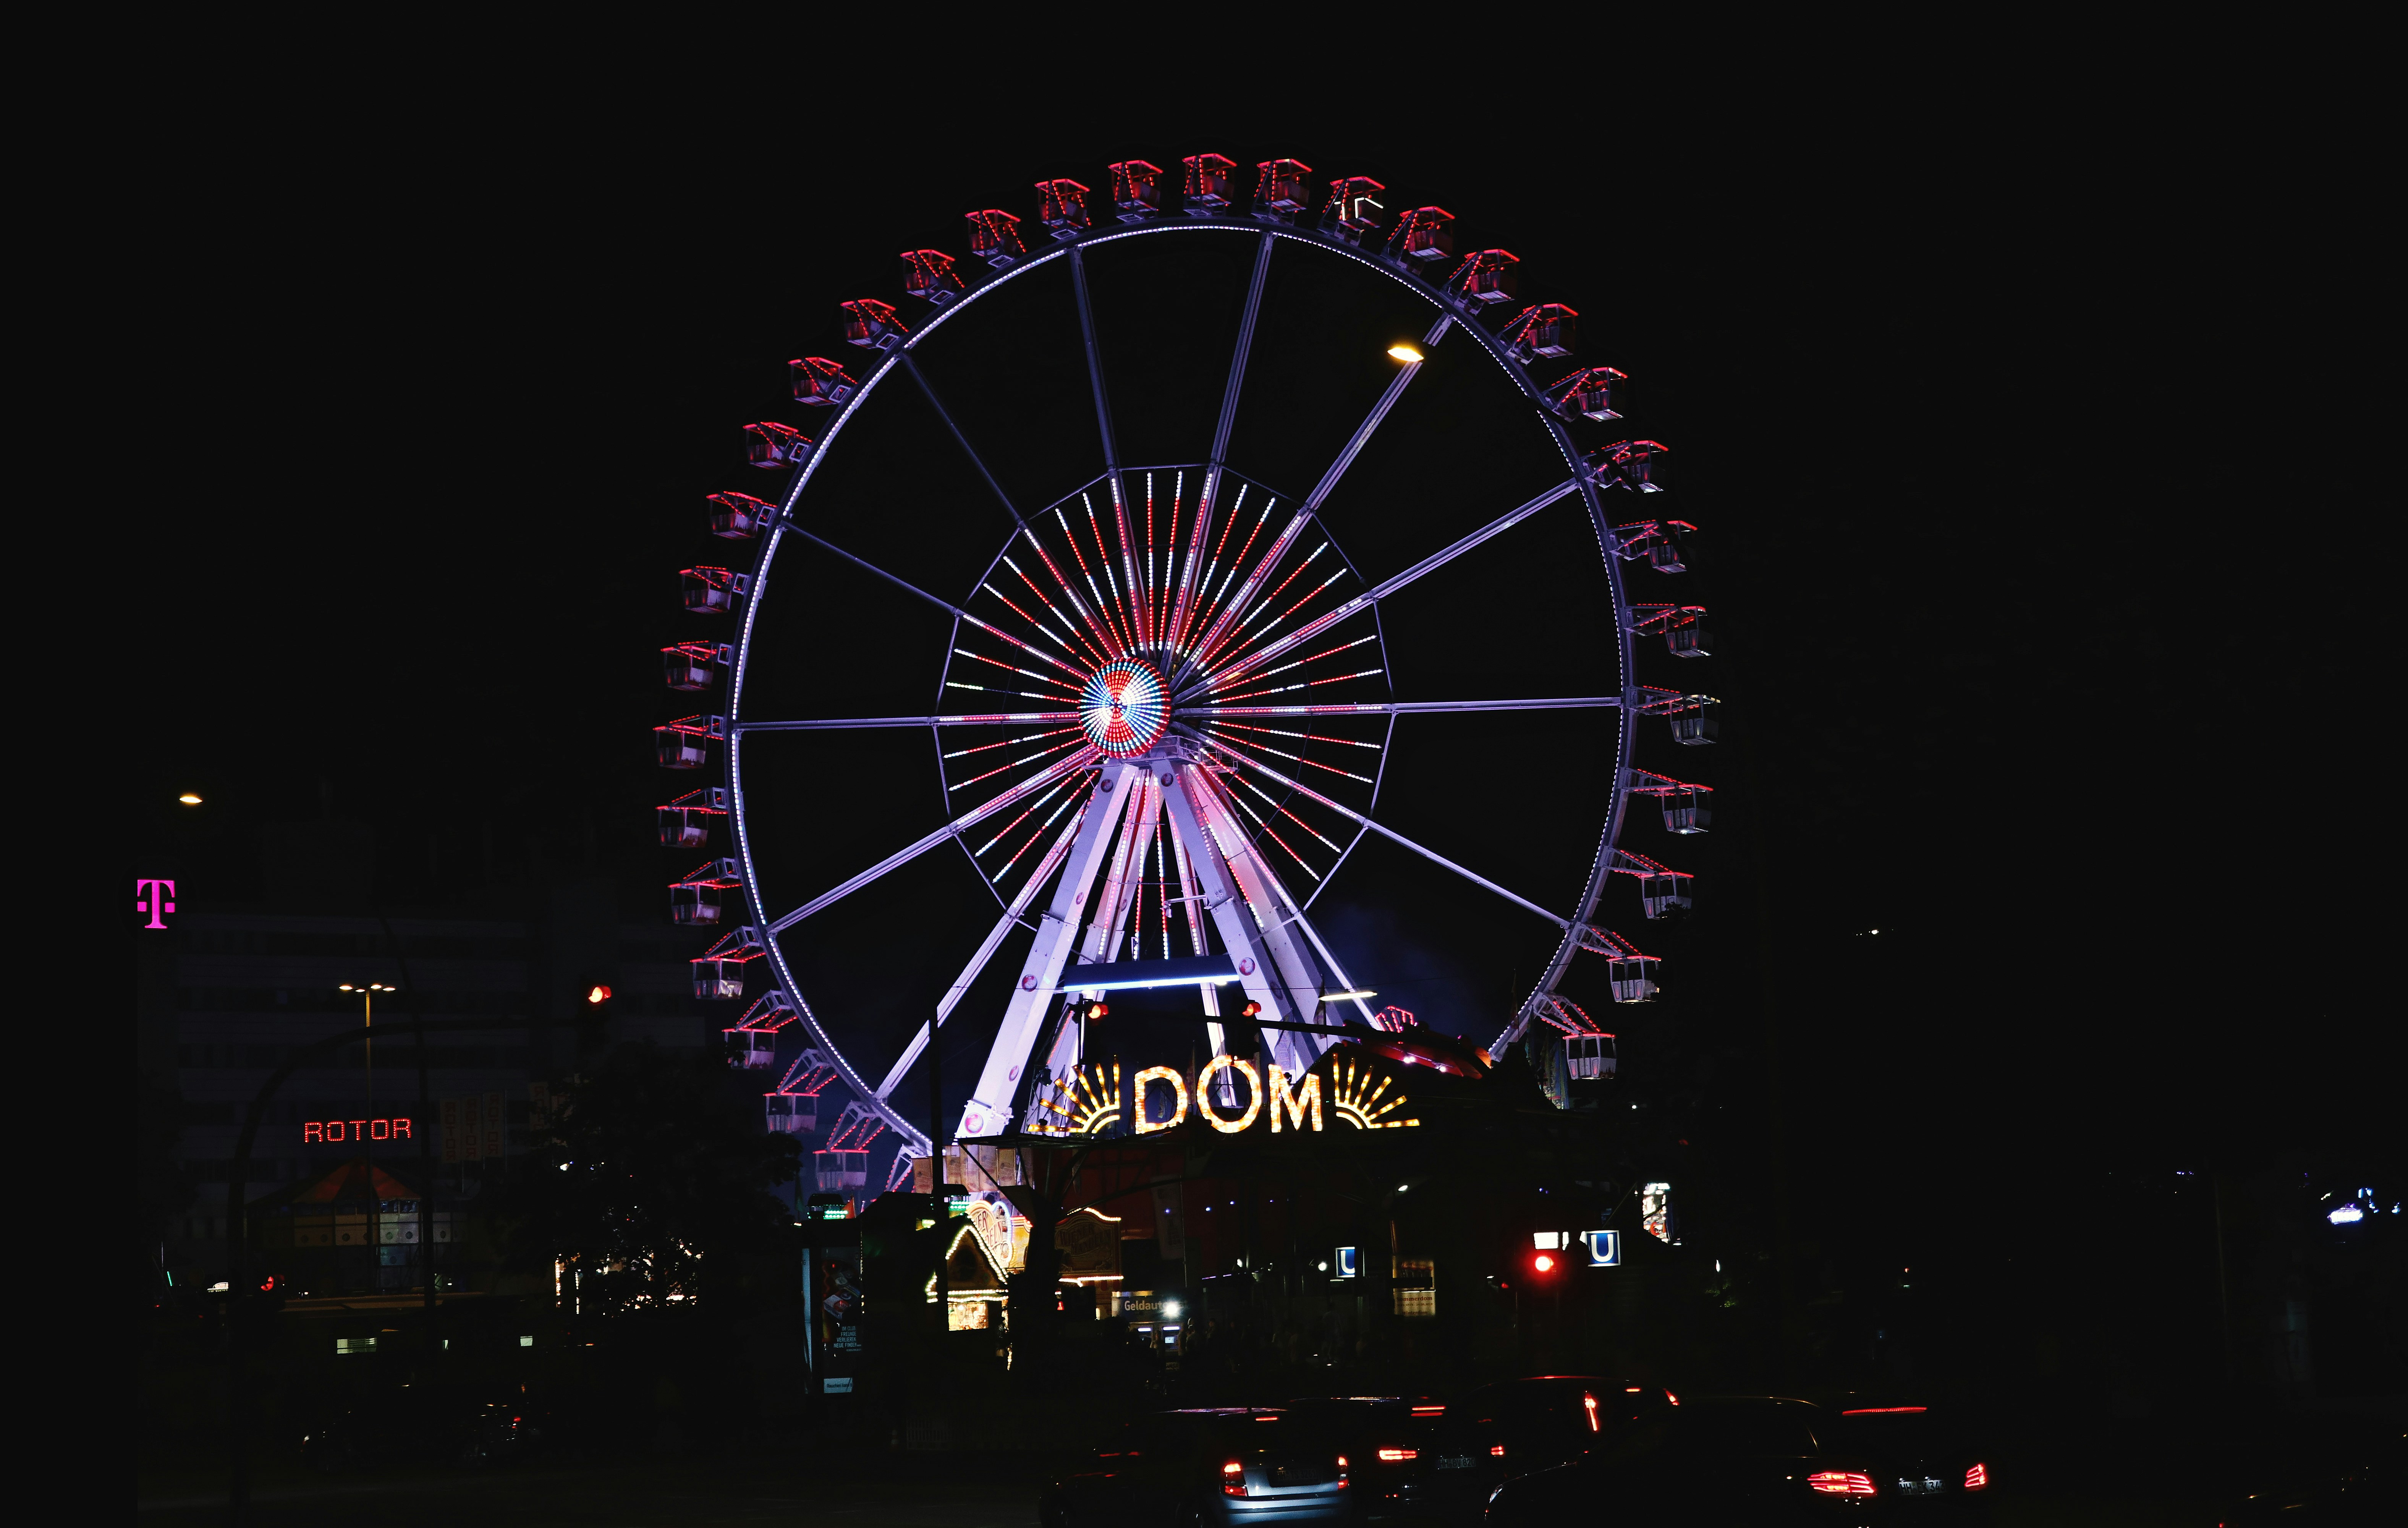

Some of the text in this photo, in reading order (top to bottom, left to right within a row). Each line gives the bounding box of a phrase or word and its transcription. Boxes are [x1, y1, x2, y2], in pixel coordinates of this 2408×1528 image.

[1134, 1054, 1323, 1135] DOM
[304, 1118, 412, 1143] ROTOR
[1591, 1233, 1614, 1263] U
